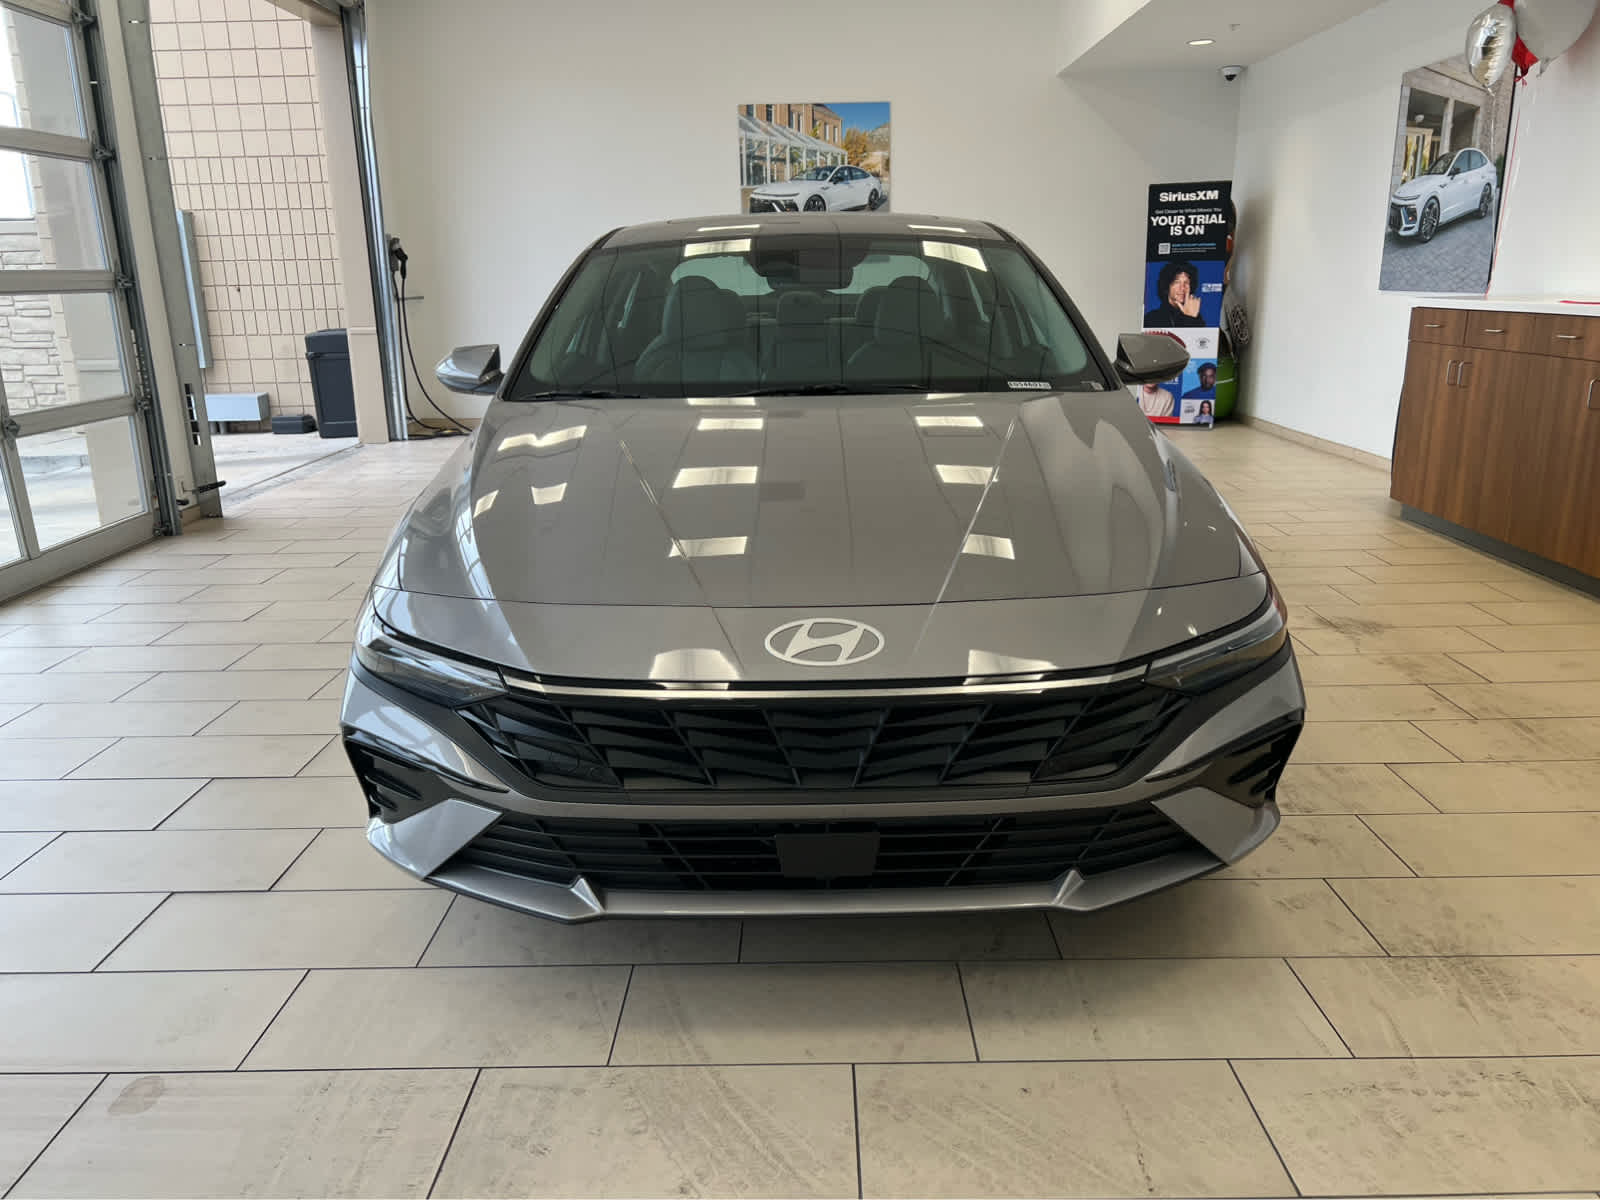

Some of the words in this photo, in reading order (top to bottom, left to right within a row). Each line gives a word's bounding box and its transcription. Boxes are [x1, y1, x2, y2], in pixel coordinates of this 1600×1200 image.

[1159, 190, 1219, 202] SiriusXM
[1151, 215, 1185, 226] YOUR
[1188, 214, 1226, 225] TRIAL
[1170, 226, 1182, 236] IS
[1185, 225, 1205, 235] ON
